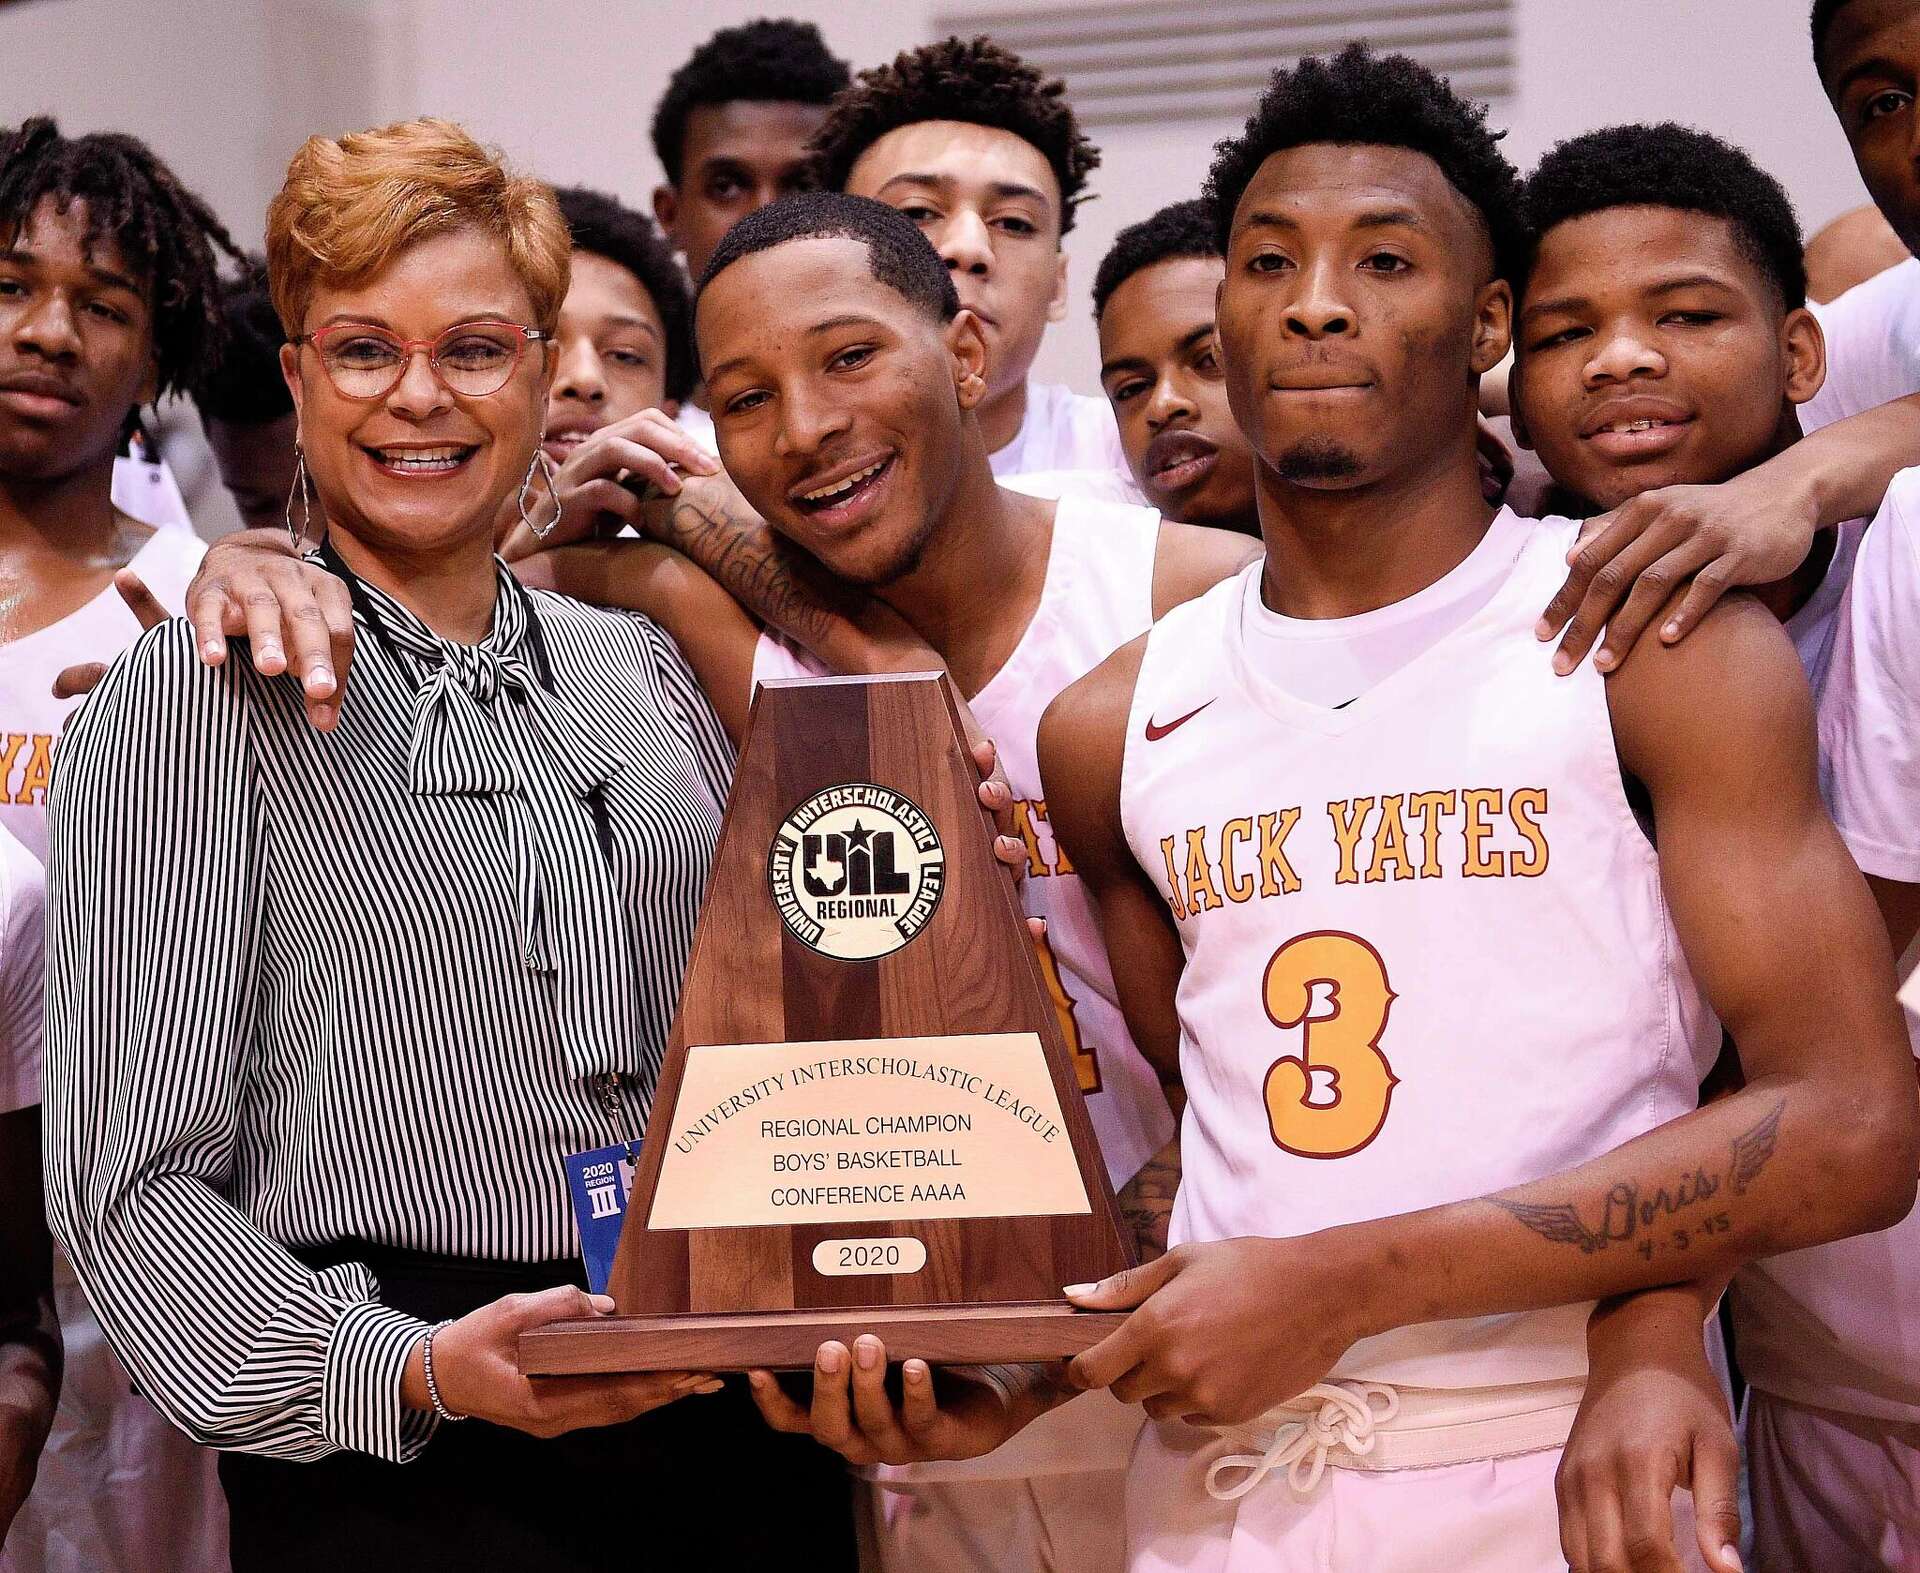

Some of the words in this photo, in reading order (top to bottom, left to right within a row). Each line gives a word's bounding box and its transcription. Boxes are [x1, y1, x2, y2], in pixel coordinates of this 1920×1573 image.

[792, 787, 936, 850] INTERSCHOLASTIC
[1160, 806, 1302, 921] JACK
[1327, 788, 1549, 884] YATES
[773, 839, 820, 943] UNIVERSITY
[899, 865, 942, 936] LEAGUE
[817, 898, 898, 919] REGIONAL
[1262, 930, 1401, 1160] 3
[674, 1073, 785, 1155] UNIVERSITY
[792, 1056, 983, 1095] INTERSCHOLASTIC
[984, 1083, 1060, 1144] LEAGUE
[761, 1118, 860, 1138] REGIONAL
[866, 1114, 972, 1135] CHAMPION
[582, 1162, 614, 1180] 2020
[773, 1153, 831, 1172] BOYS'
[837, 1149, 962, 1170] BASKETBALL
[585, 1175, 615, 1189] REGION
[771, 1184, 905, 1207] CONFERENCE
[911, 1183, 966, 1202] AAAA
[587, 1184, 622, 1220] III
[838, 1246, 900, 1267] 2020
